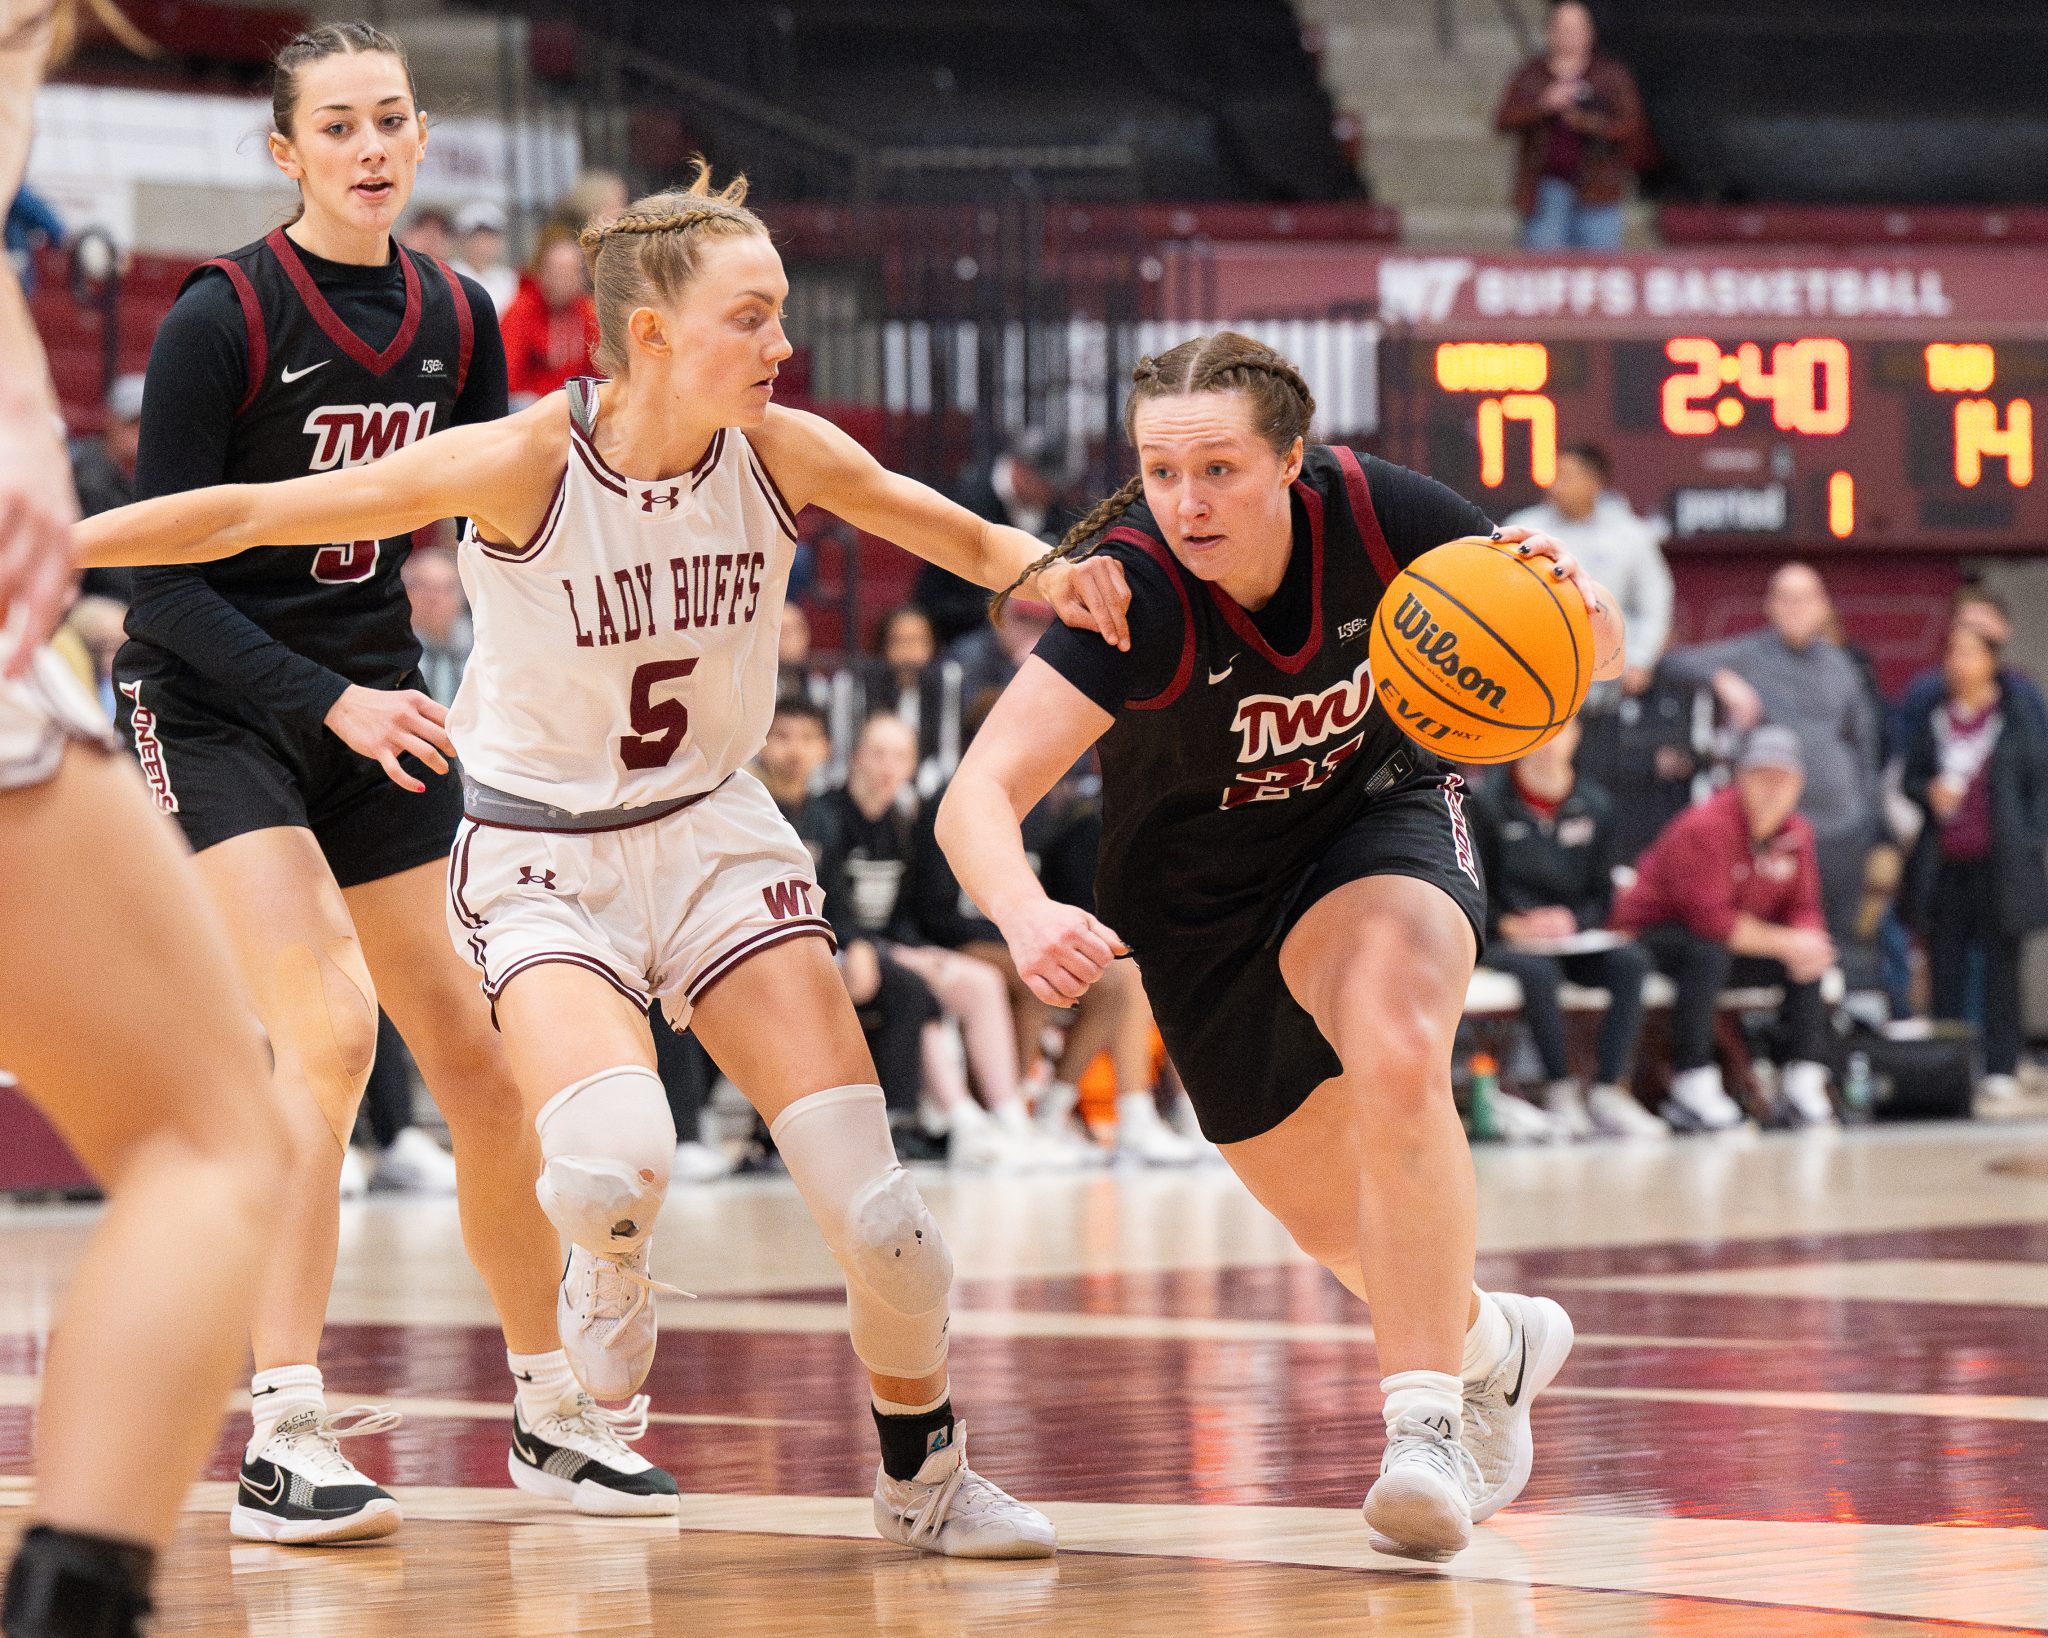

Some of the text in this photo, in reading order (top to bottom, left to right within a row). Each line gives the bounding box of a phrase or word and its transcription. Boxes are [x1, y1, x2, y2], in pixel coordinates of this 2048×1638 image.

[1476, 266, 1637, 318] BUFFS
[1644, 266, 1953, 318] BASKETBALL
[1662, 336, 1850, 436] 2:40
[1477, 393, 1558, 489] 17
[1953, 397, 2034, 489] 14
[1828, 469, 1855, 540] 1
[561, 551, 766, 648] LADY BUFFS
[1393, 591, 1508, 710] Wilson
[118, 679, 181, 816] ONEERS
[619, 656, 701, 771] 5
[1229, 657, 1376, 764] TWU
[1379, 677, 1483, 742] EVO NXT
[761, 879, 812, 920] WT
[291, 1410, 316, 1424] CUT
